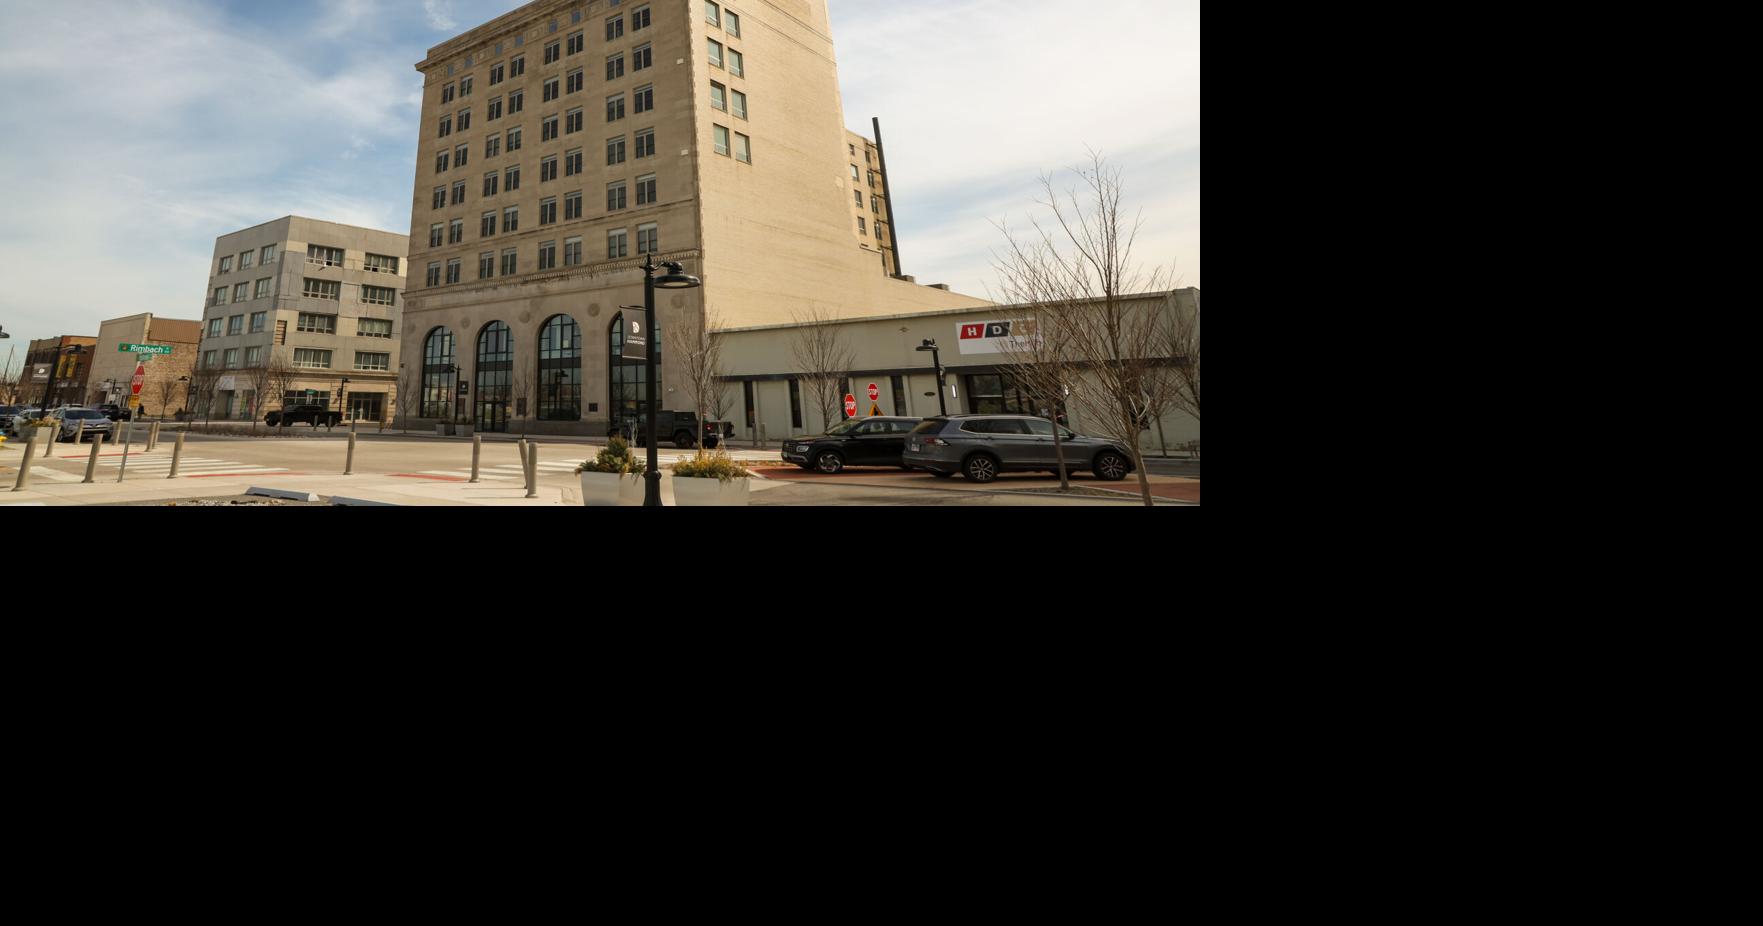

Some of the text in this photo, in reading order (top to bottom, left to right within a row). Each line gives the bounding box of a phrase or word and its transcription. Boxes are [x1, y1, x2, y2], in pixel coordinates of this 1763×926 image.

[130, 344, 164, 354] Rimbach
[132, 374, 145, 386] STOP
[867, 388, 879, 396] STOP
[845, 401, 856, 410] STOP
